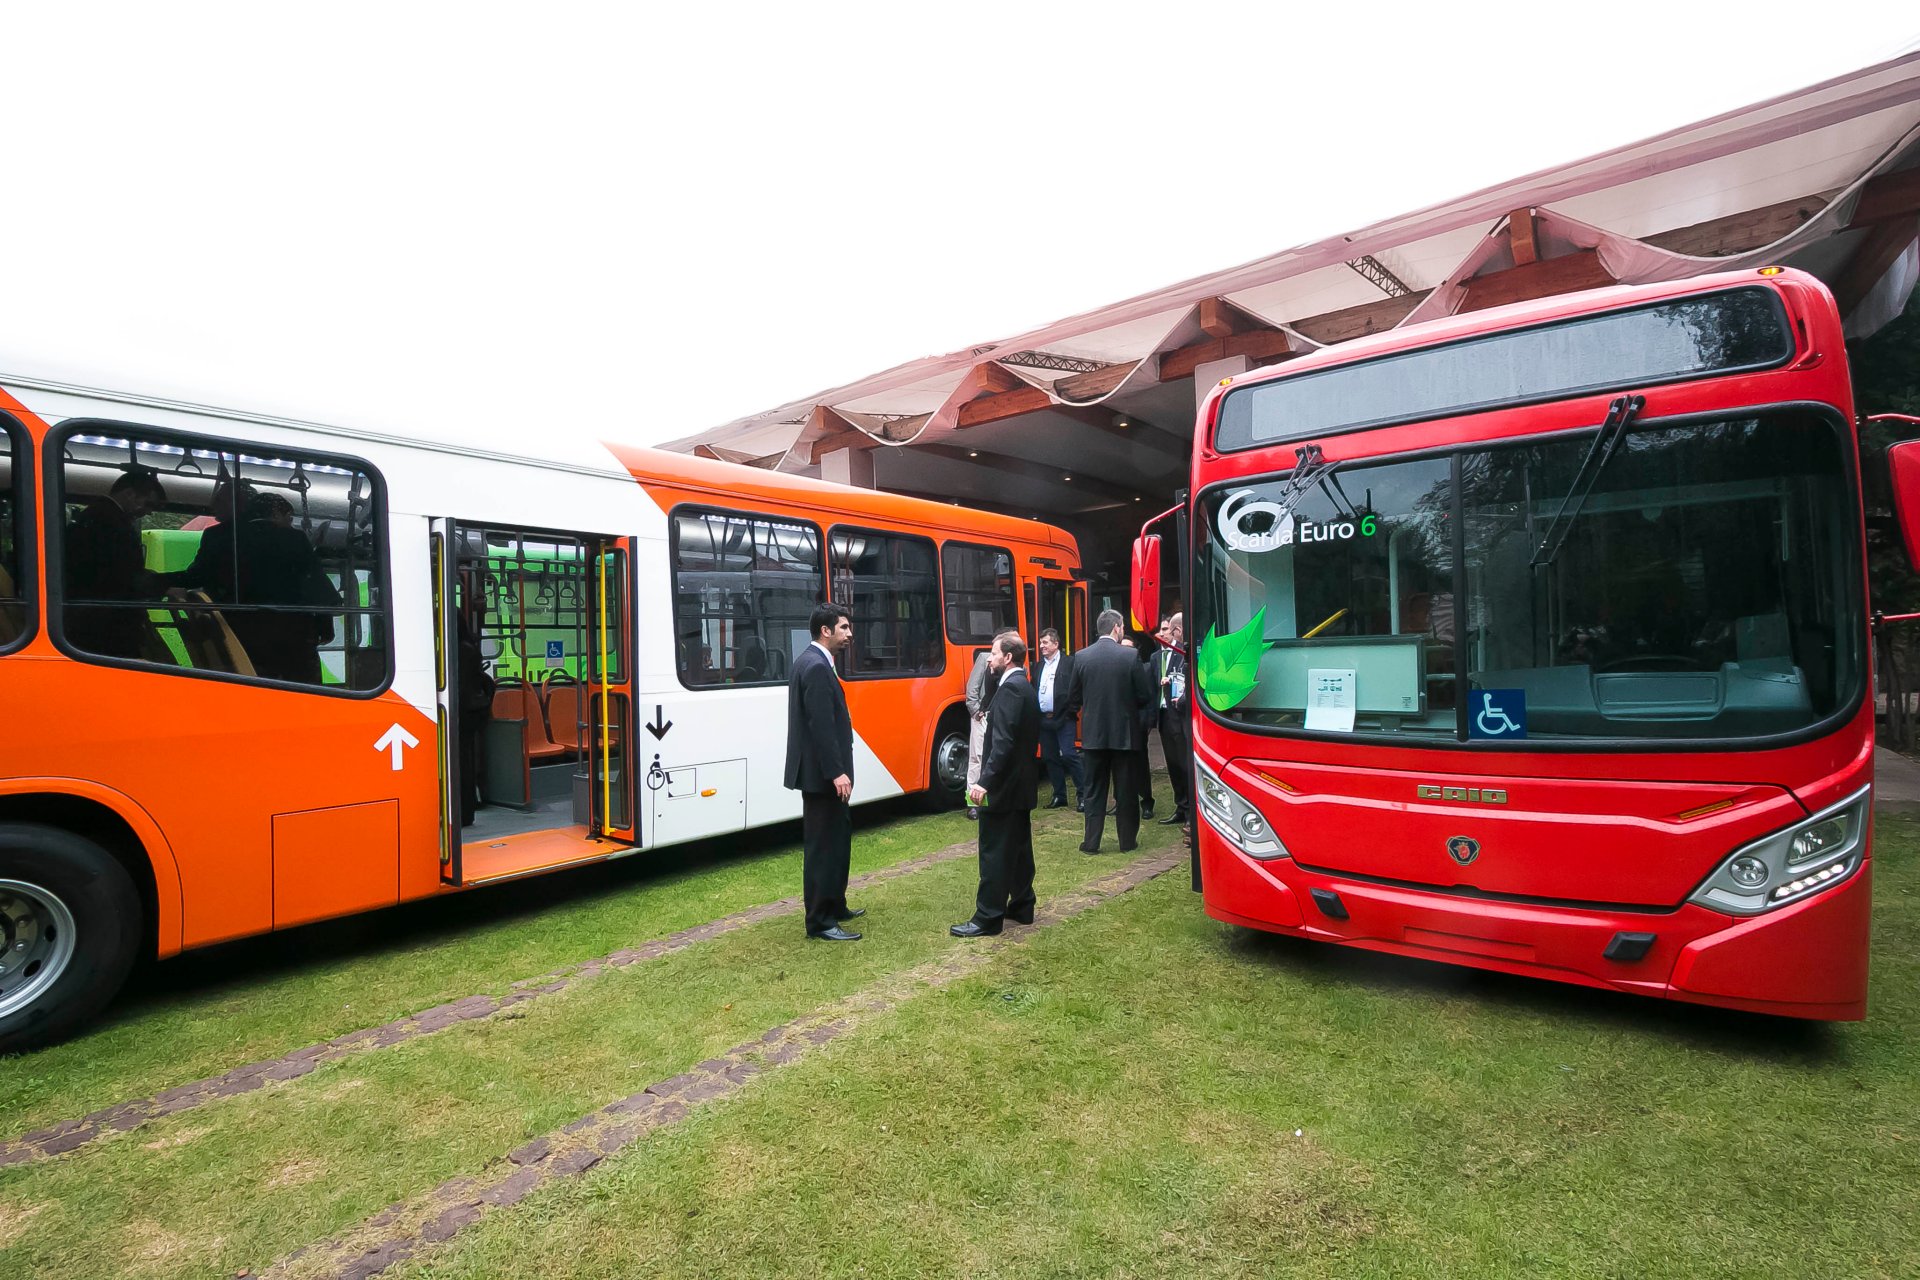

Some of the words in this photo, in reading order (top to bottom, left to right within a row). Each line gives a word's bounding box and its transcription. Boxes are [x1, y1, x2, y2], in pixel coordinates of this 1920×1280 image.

[1300, 522, 1355, 543] Euro
[1361, 515, 1377, 537] 6
[1417, 784, 1508, 804] CAIO
